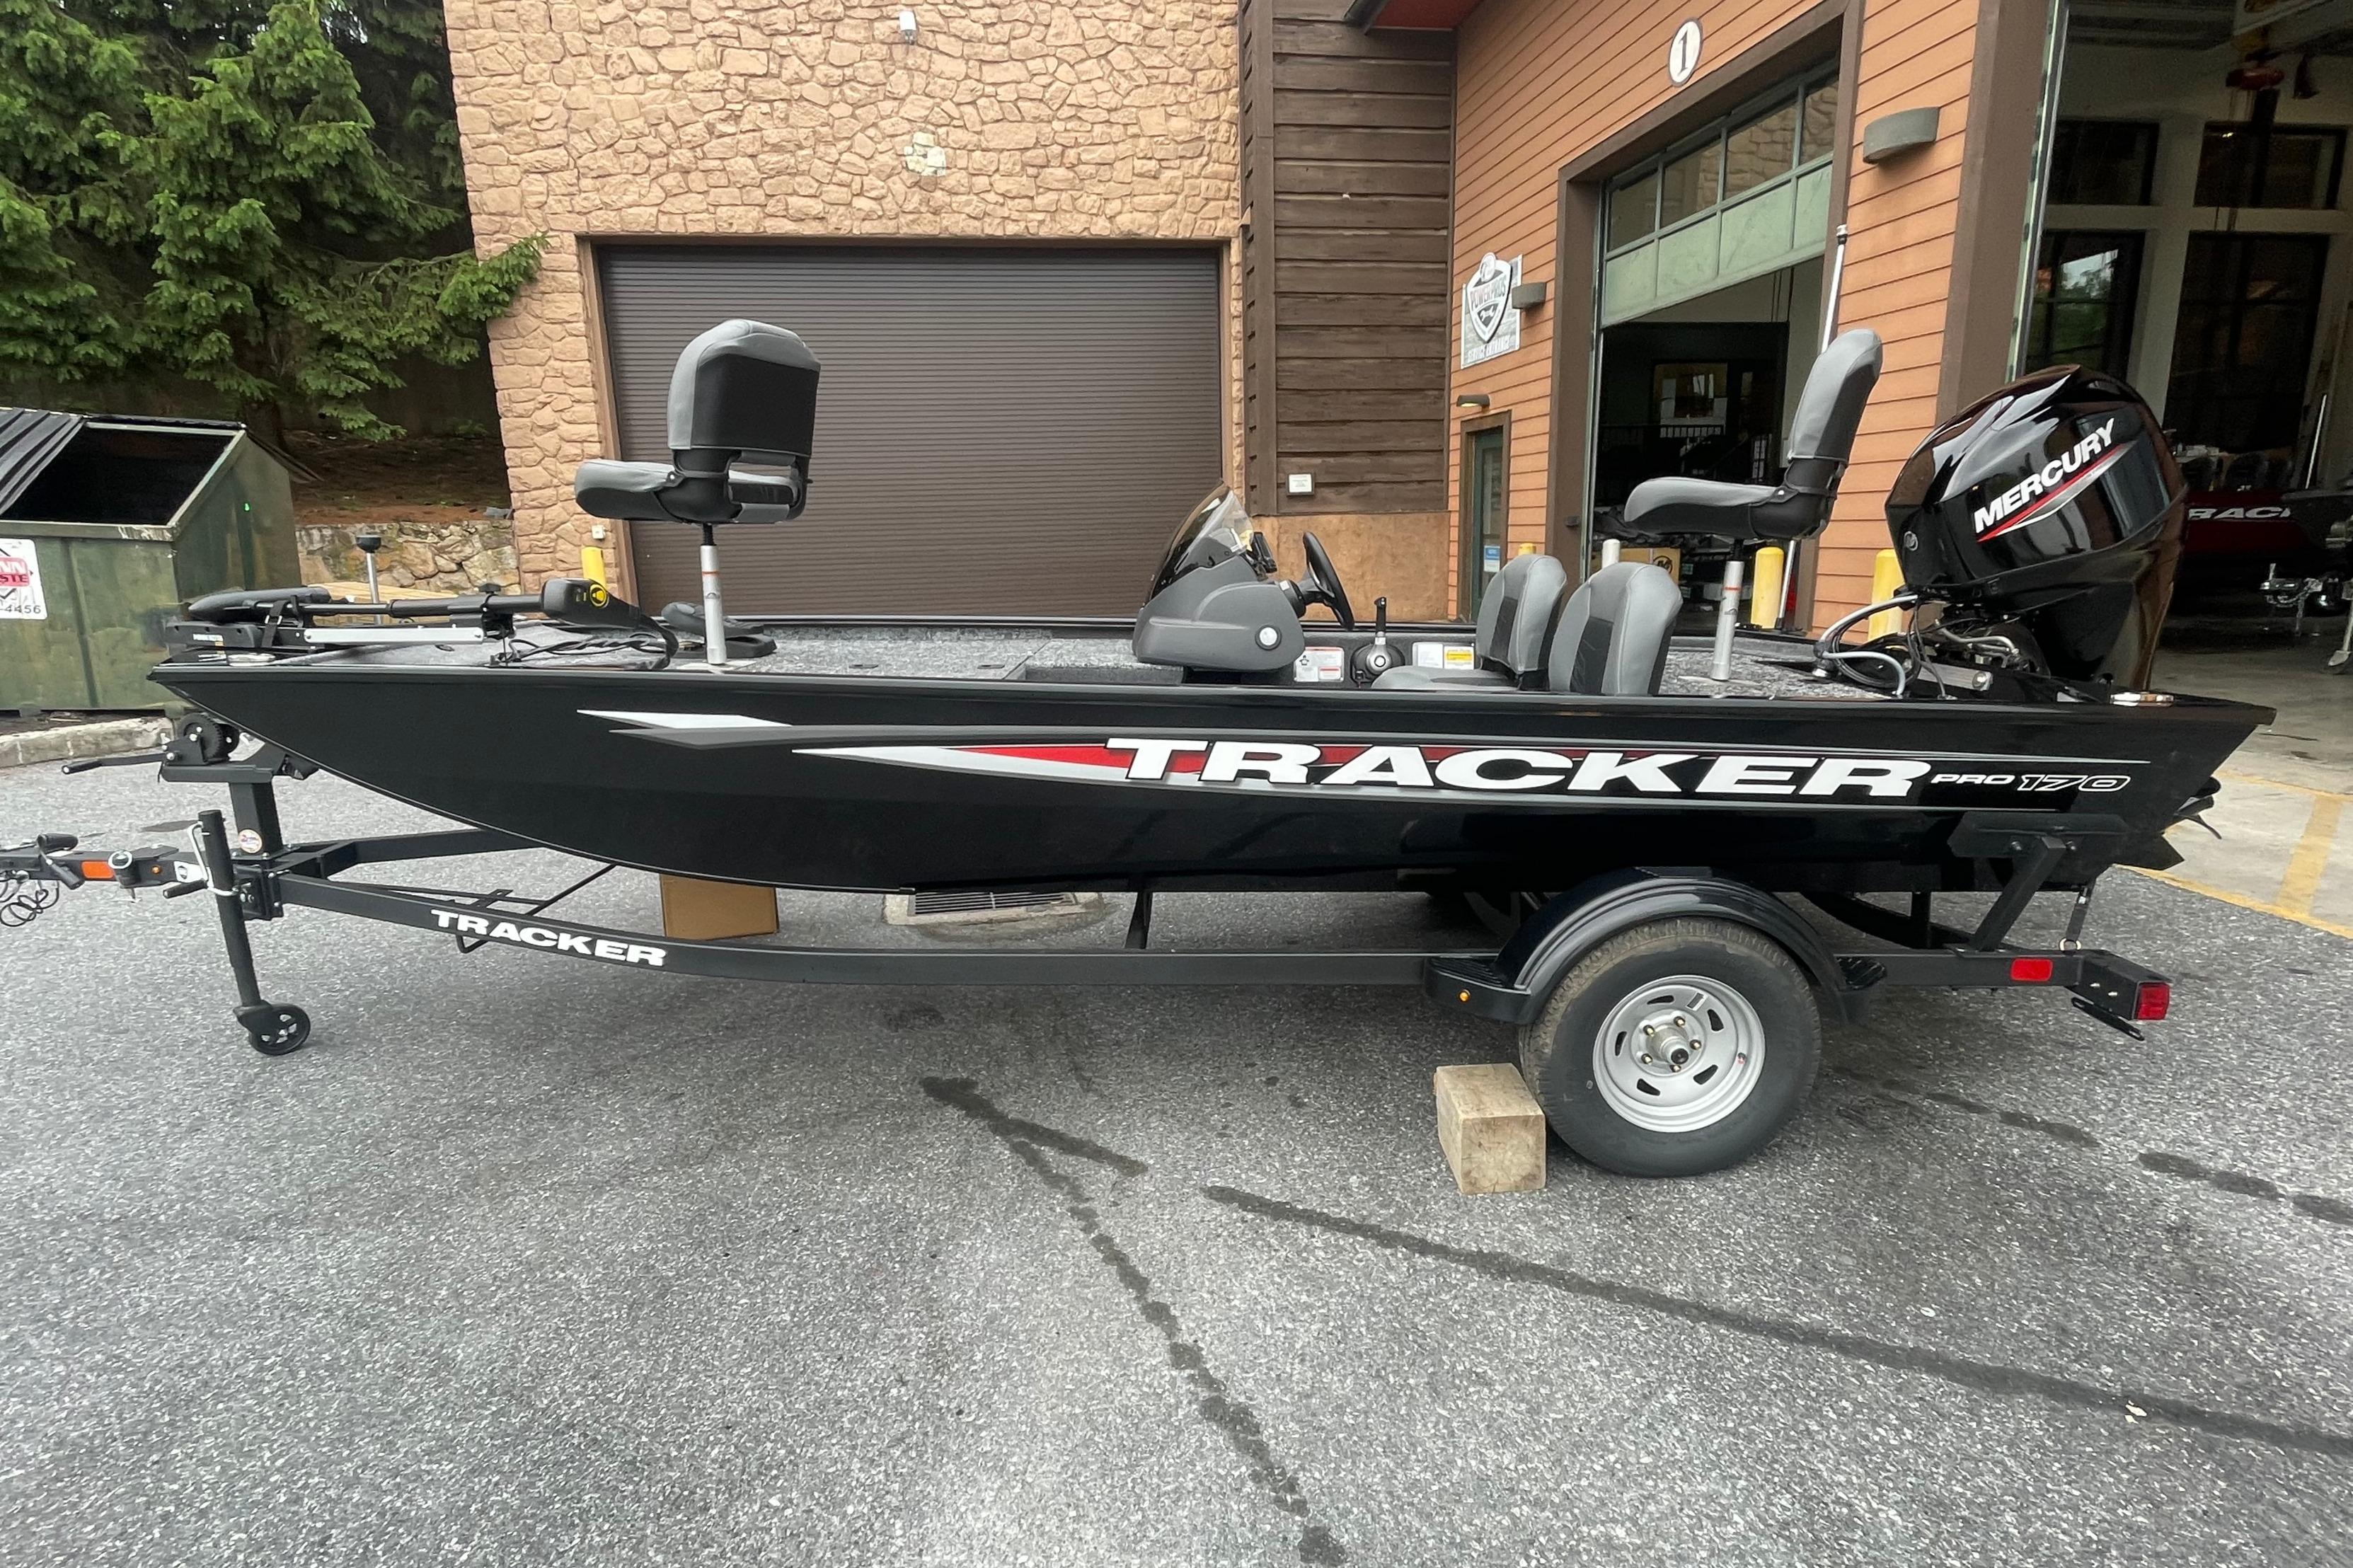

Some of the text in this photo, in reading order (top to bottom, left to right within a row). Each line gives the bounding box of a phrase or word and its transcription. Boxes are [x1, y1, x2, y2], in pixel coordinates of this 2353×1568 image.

[1678, 30, 1688, 76] 1
[1974, 417, 2115, 533] MERCURY
[1106, 737, 2131, 796] TRACKER PRO 170
[431, 909, 666, 967] TRACKER
